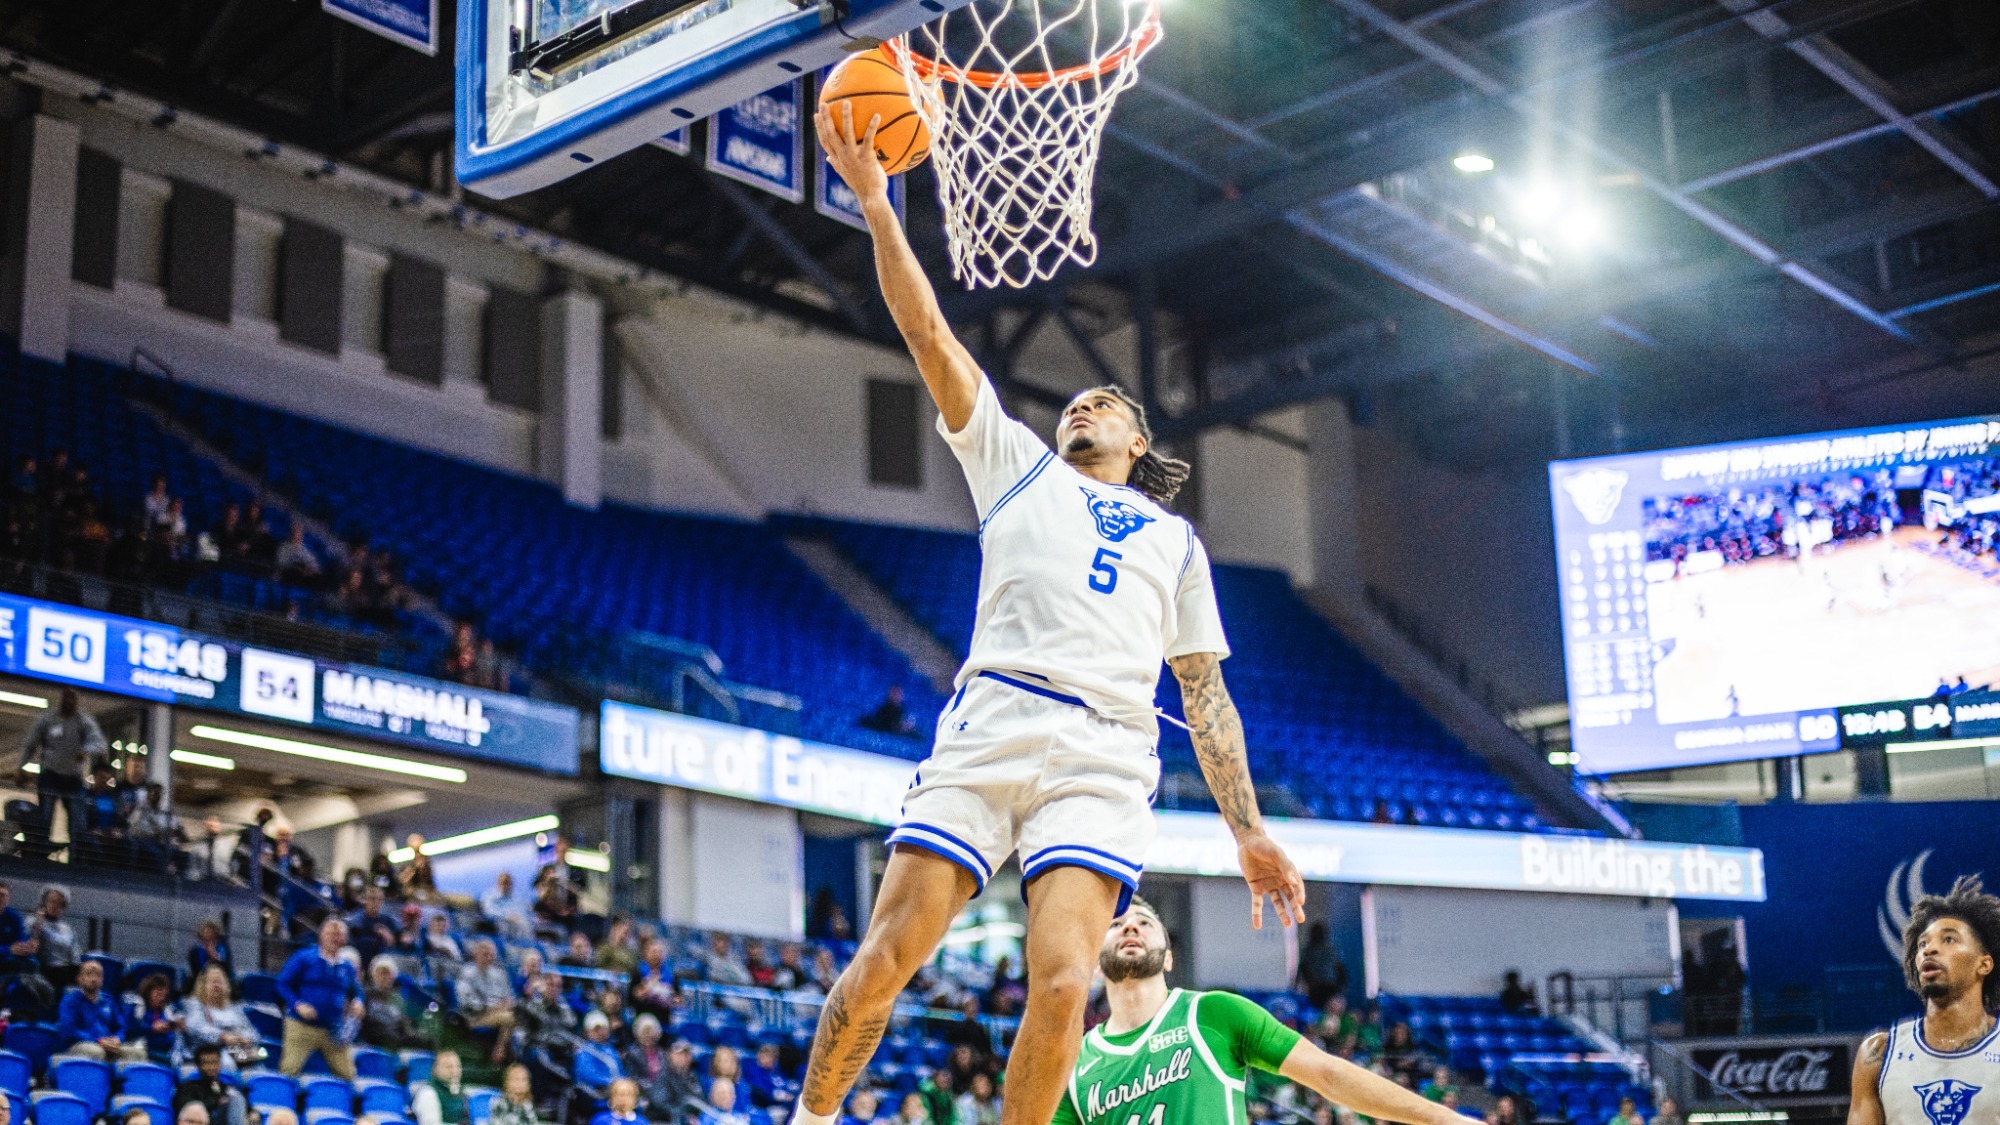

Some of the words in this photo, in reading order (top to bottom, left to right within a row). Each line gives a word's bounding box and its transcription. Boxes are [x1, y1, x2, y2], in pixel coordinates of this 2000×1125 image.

[1088, 547, 1123, 595] 5
[42, 627, 92, 663] 50
[123, 629, 228, 682] 13:48
[256, 670, 299, 700] 54
[322, 669, 491, 734] MARSHALL
[607, 709, 706, 782] ture
[713, 731, 766, 793] of
[1520, 834, 1677, 898] Building
[1680, 846, 1743, 896] the
[1148, 1025, 1189, 1053] SBC
[1086, 1046, 1193, 1123] Marshall
